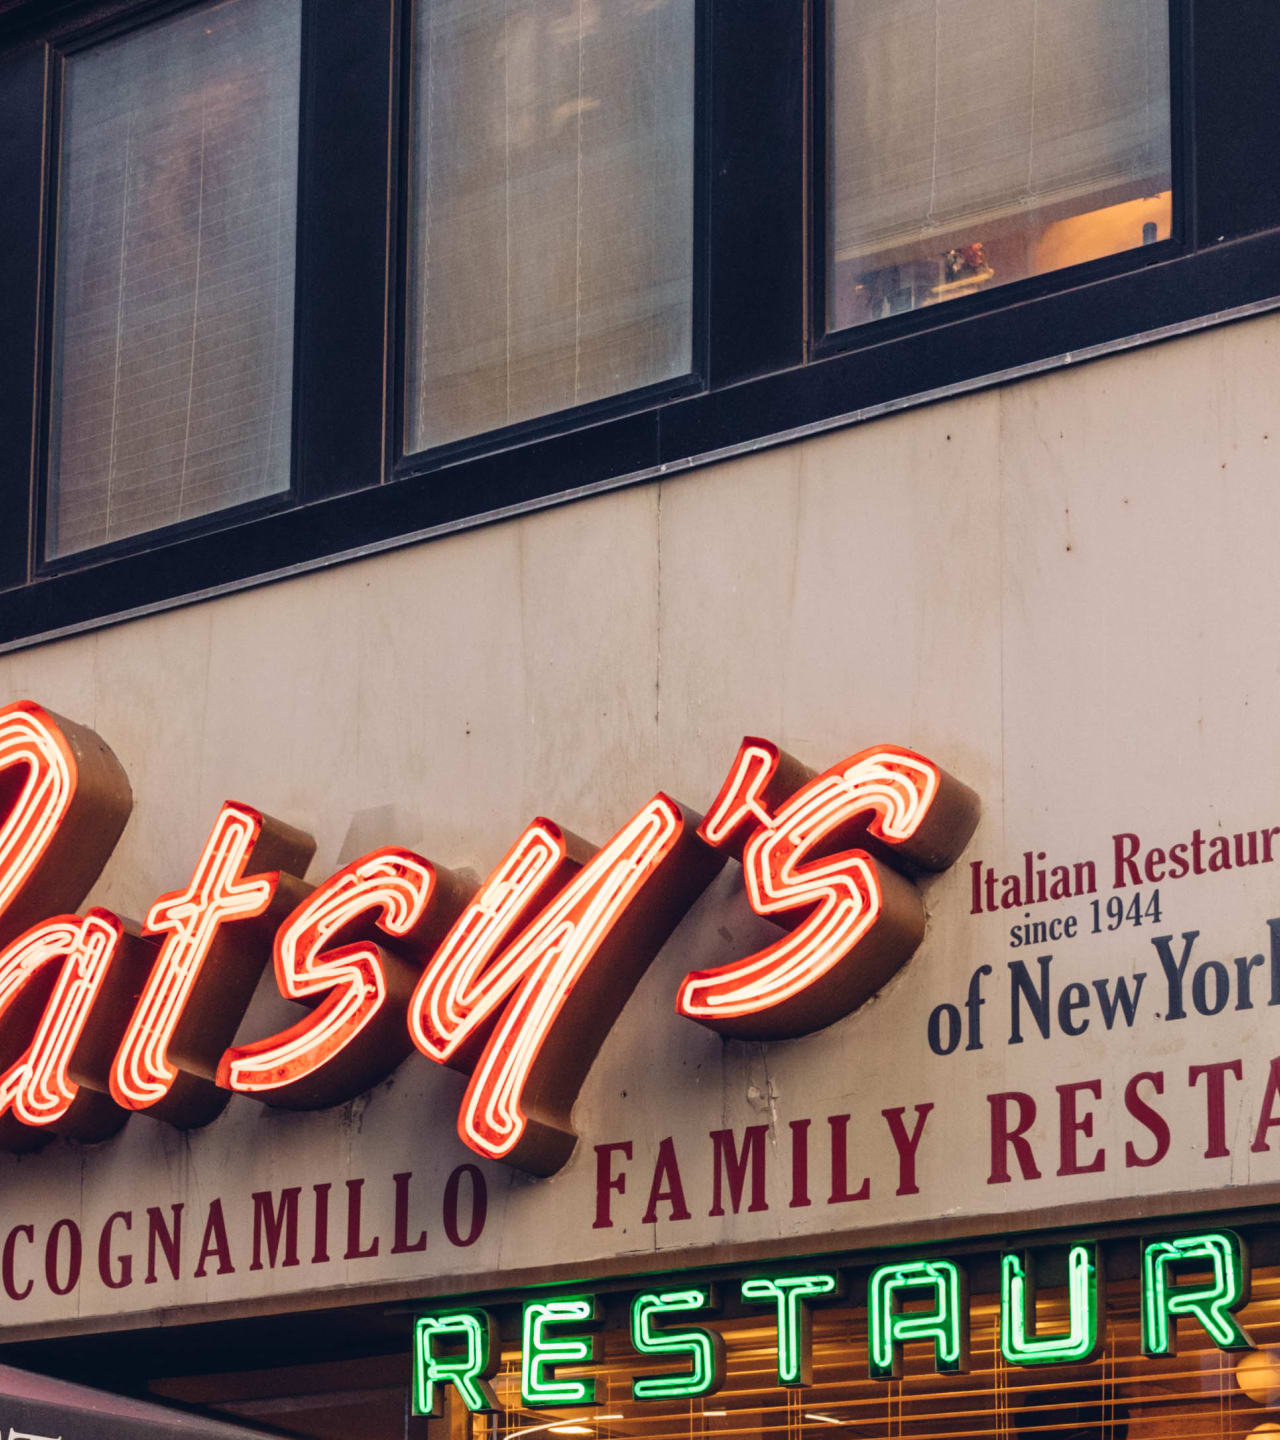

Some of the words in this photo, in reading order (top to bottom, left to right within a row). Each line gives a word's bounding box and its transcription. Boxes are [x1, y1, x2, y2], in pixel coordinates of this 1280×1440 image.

[968, 853, 1099, 915] Italian
[1008, 914, 1078, 948] since
[1089, 889, 1163, 935] 1944
[927, 964, 992, 1057] of
[1007, 954, 1146, 1047] New
[593, 1103, 935, 1230] FAMILY
